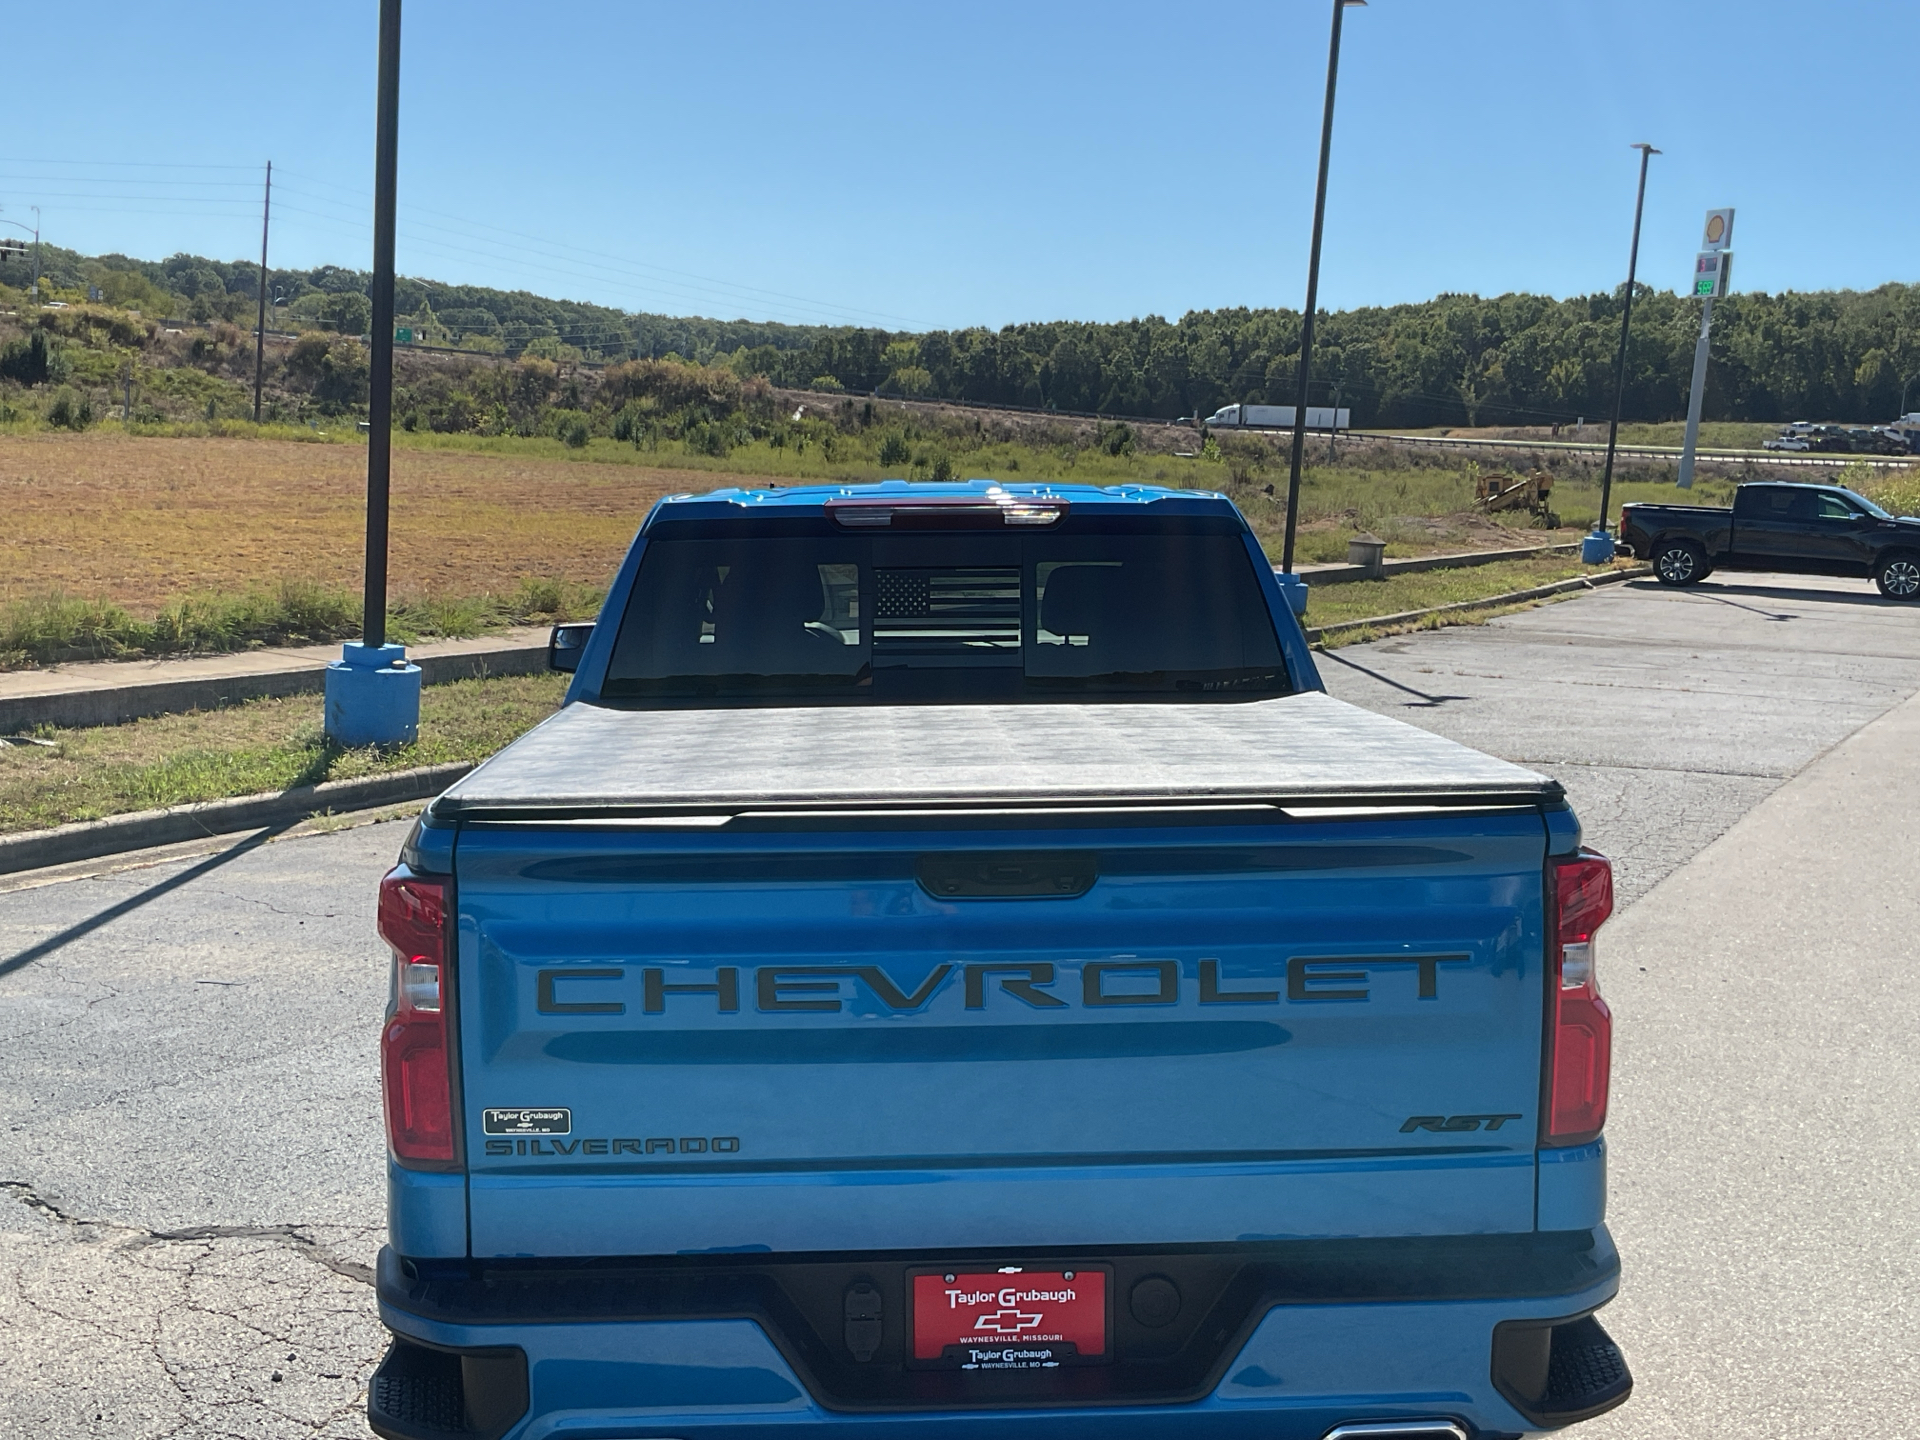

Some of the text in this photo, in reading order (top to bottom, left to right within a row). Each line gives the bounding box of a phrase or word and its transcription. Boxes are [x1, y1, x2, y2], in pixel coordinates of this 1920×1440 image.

[536, 953, 1473, 1015] CHEVROLET
[491, 1111, 563, 1122] Taylor Grubaugh
[1399, 1113, 1523, 1133] RST
[485, 1137, 740, 1156] SILVERADO
[945, 1288, 1076, 1308] Taylor Grubaugh
[959, 1334, 1063, 1344] WAYNESVILLE, MISSOURI
[969, 1349, 1052, 1362] Taylor Grubaugh
